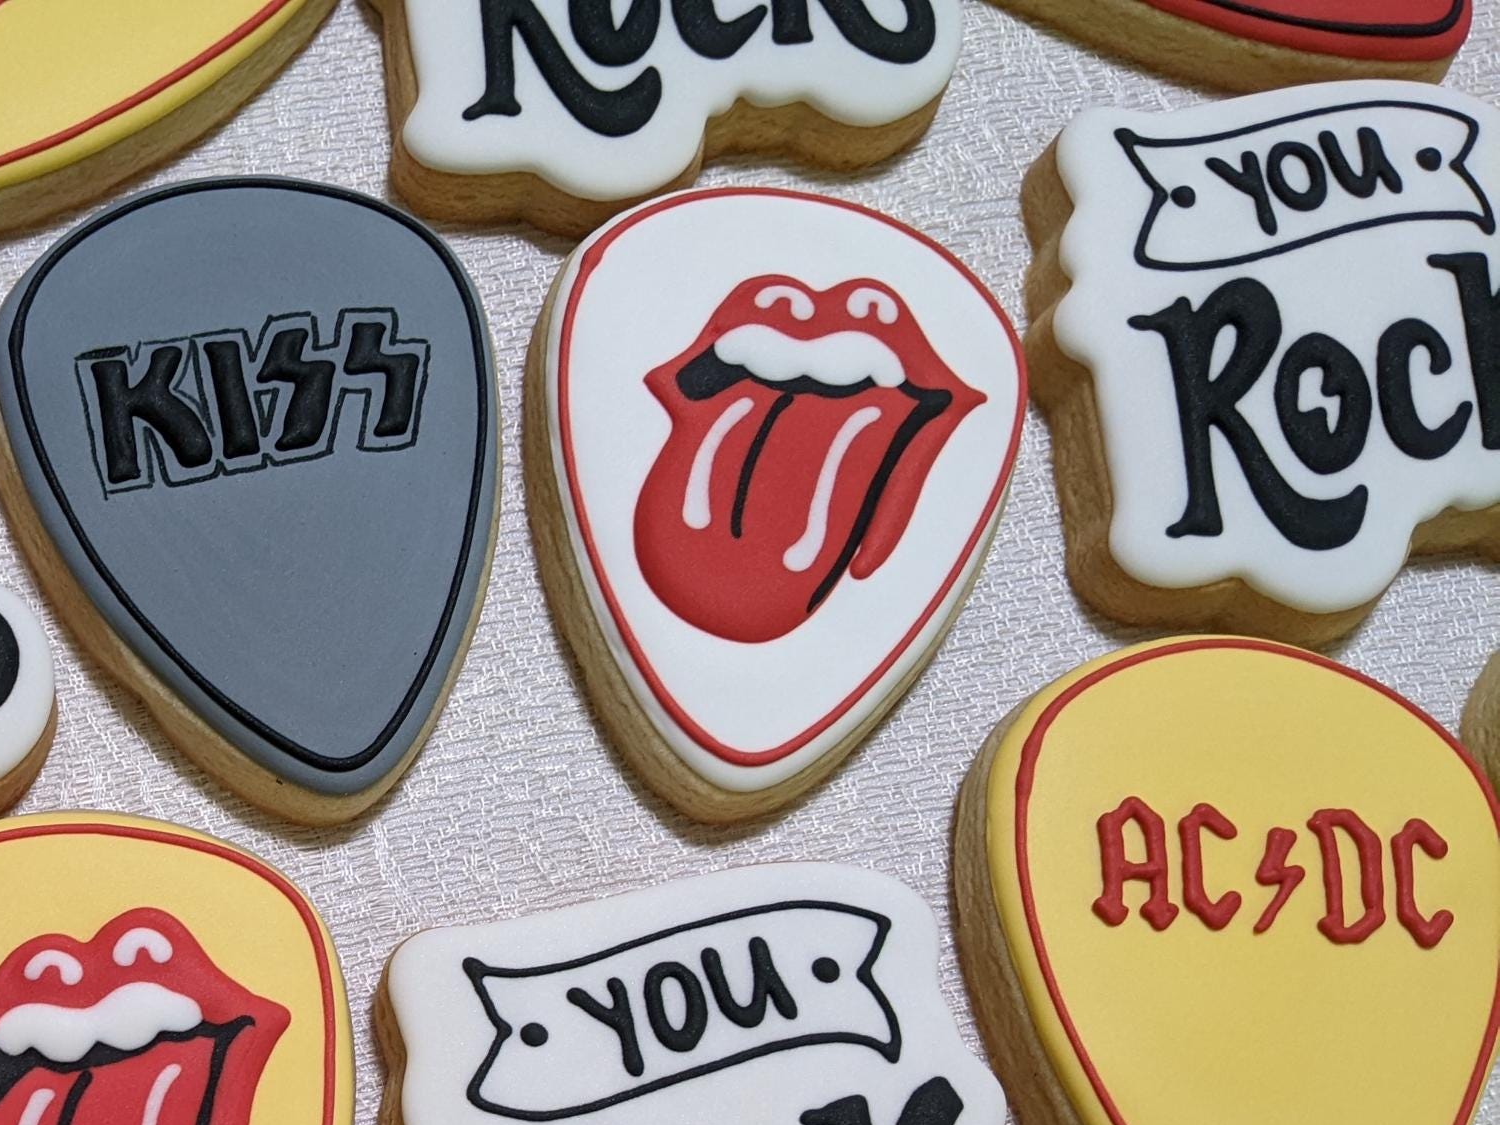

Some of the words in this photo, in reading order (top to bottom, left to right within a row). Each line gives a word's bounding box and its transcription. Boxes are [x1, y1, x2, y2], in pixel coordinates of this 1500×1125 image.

[1205, 127, 1402, 235] YOU
[74, 307, 430, 499] KISS
[567, 937, 798, 1076] YOU
